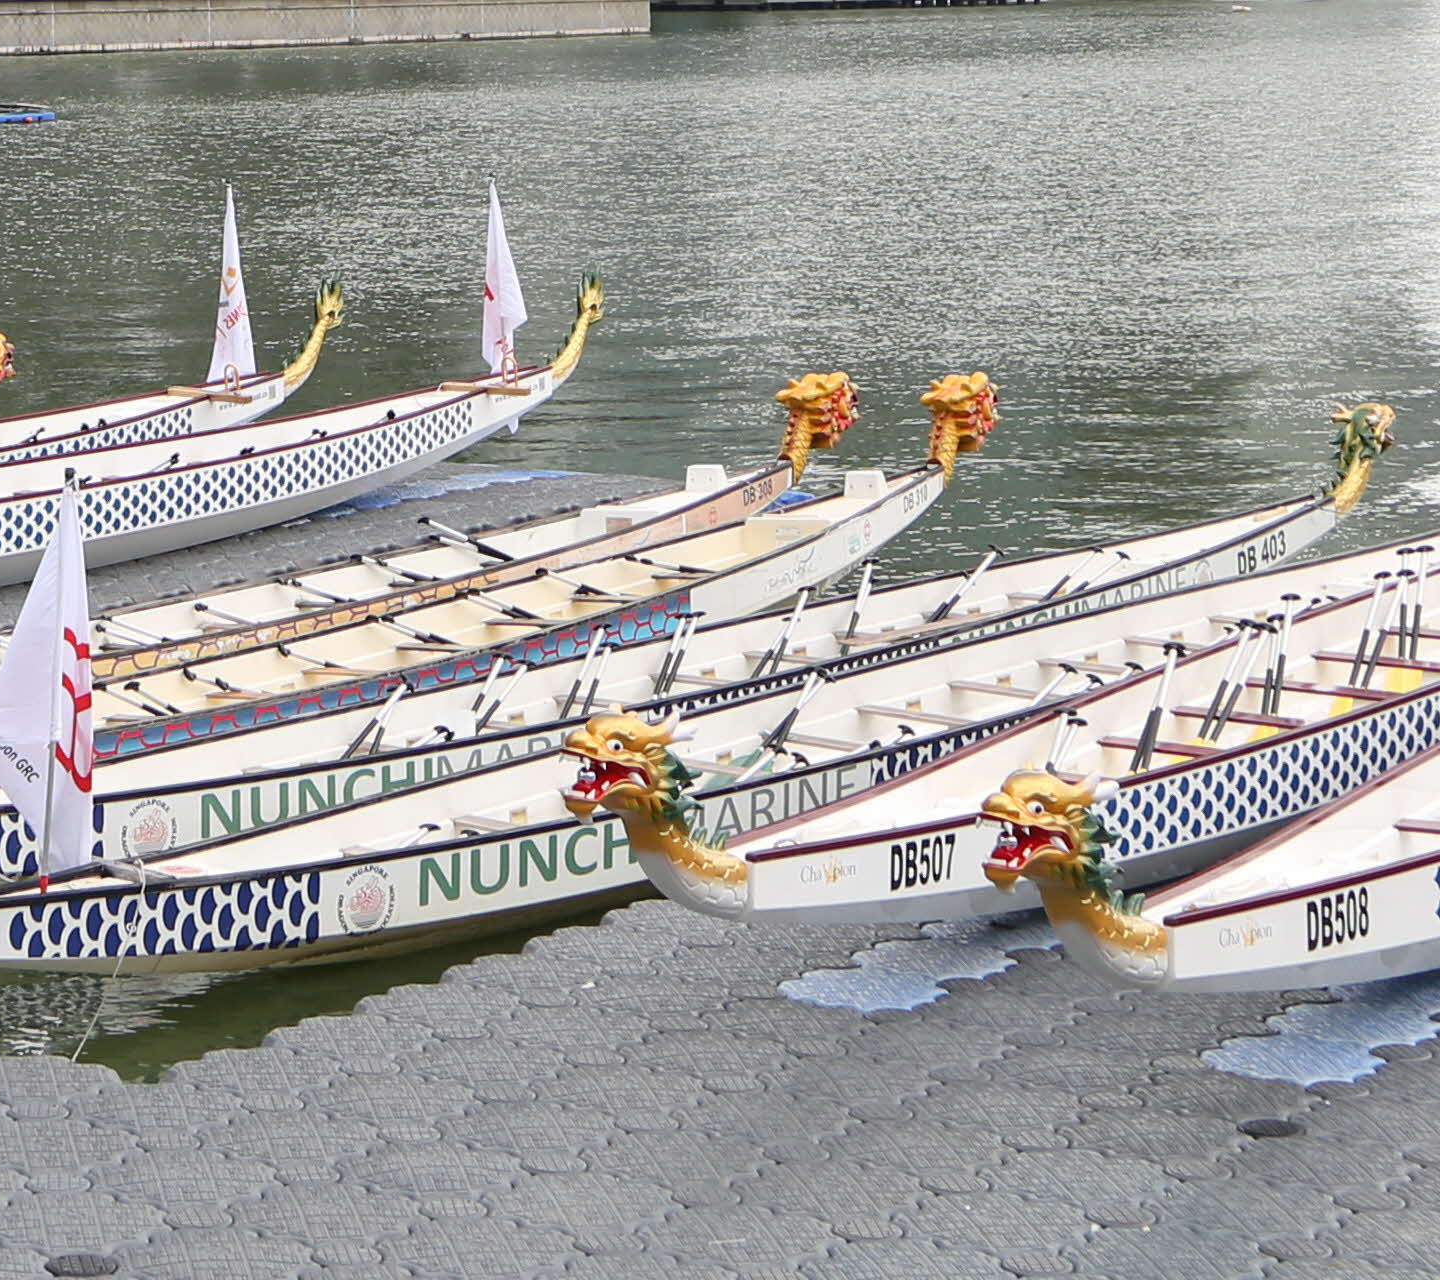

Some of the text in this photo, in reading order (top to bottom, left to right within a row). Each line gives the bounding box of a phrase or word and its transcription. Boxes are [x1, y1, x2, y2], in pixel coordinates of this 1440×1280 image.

[743, 487, 757, 506] DB
[903, 485, 928, 513] DB 310
[1237, 532, 1286, 574] DB 403
[16, 758, 40, 783] GRC
[890, 833, 956, 891] DB507
[1307, 885, 1369, 952] DB508
